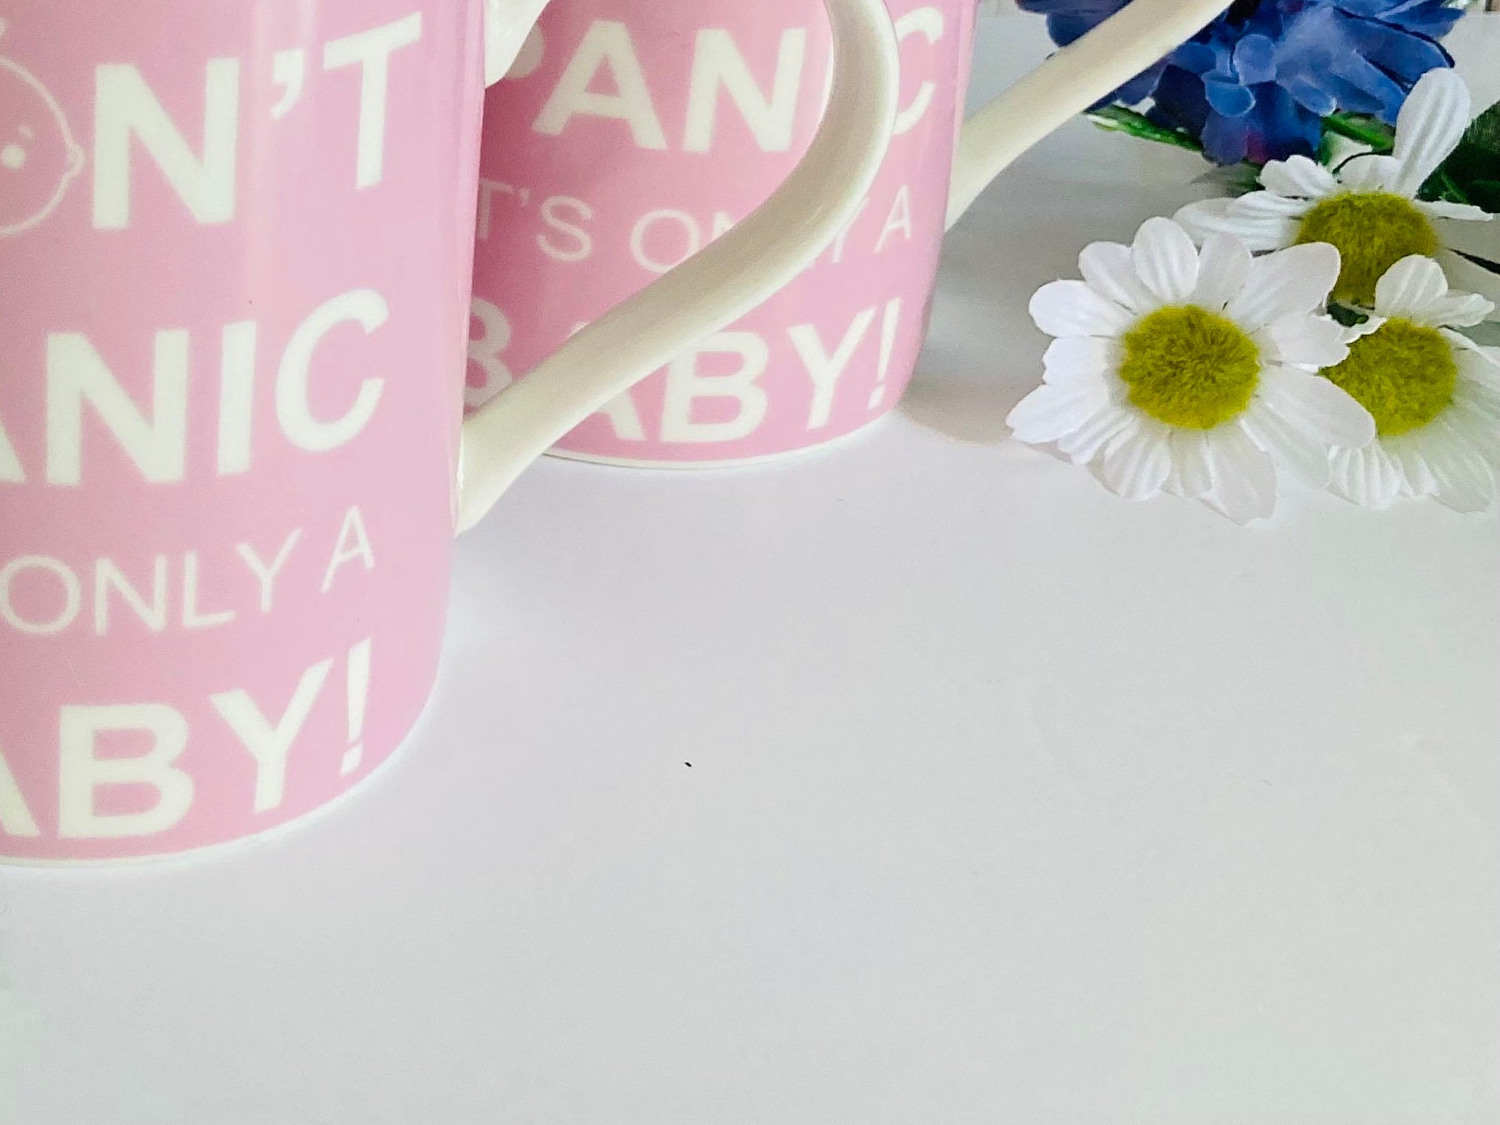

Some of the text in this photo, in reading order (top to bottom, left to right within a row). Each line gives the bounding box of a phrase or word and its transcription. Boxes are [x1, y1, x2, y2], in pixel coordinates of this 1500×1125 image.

[503, 6, 944, 153] ANC
[473, 177, 594, 263] T'S
[874, 185, 912, 254] A
[321, 506, 376, 593] A
